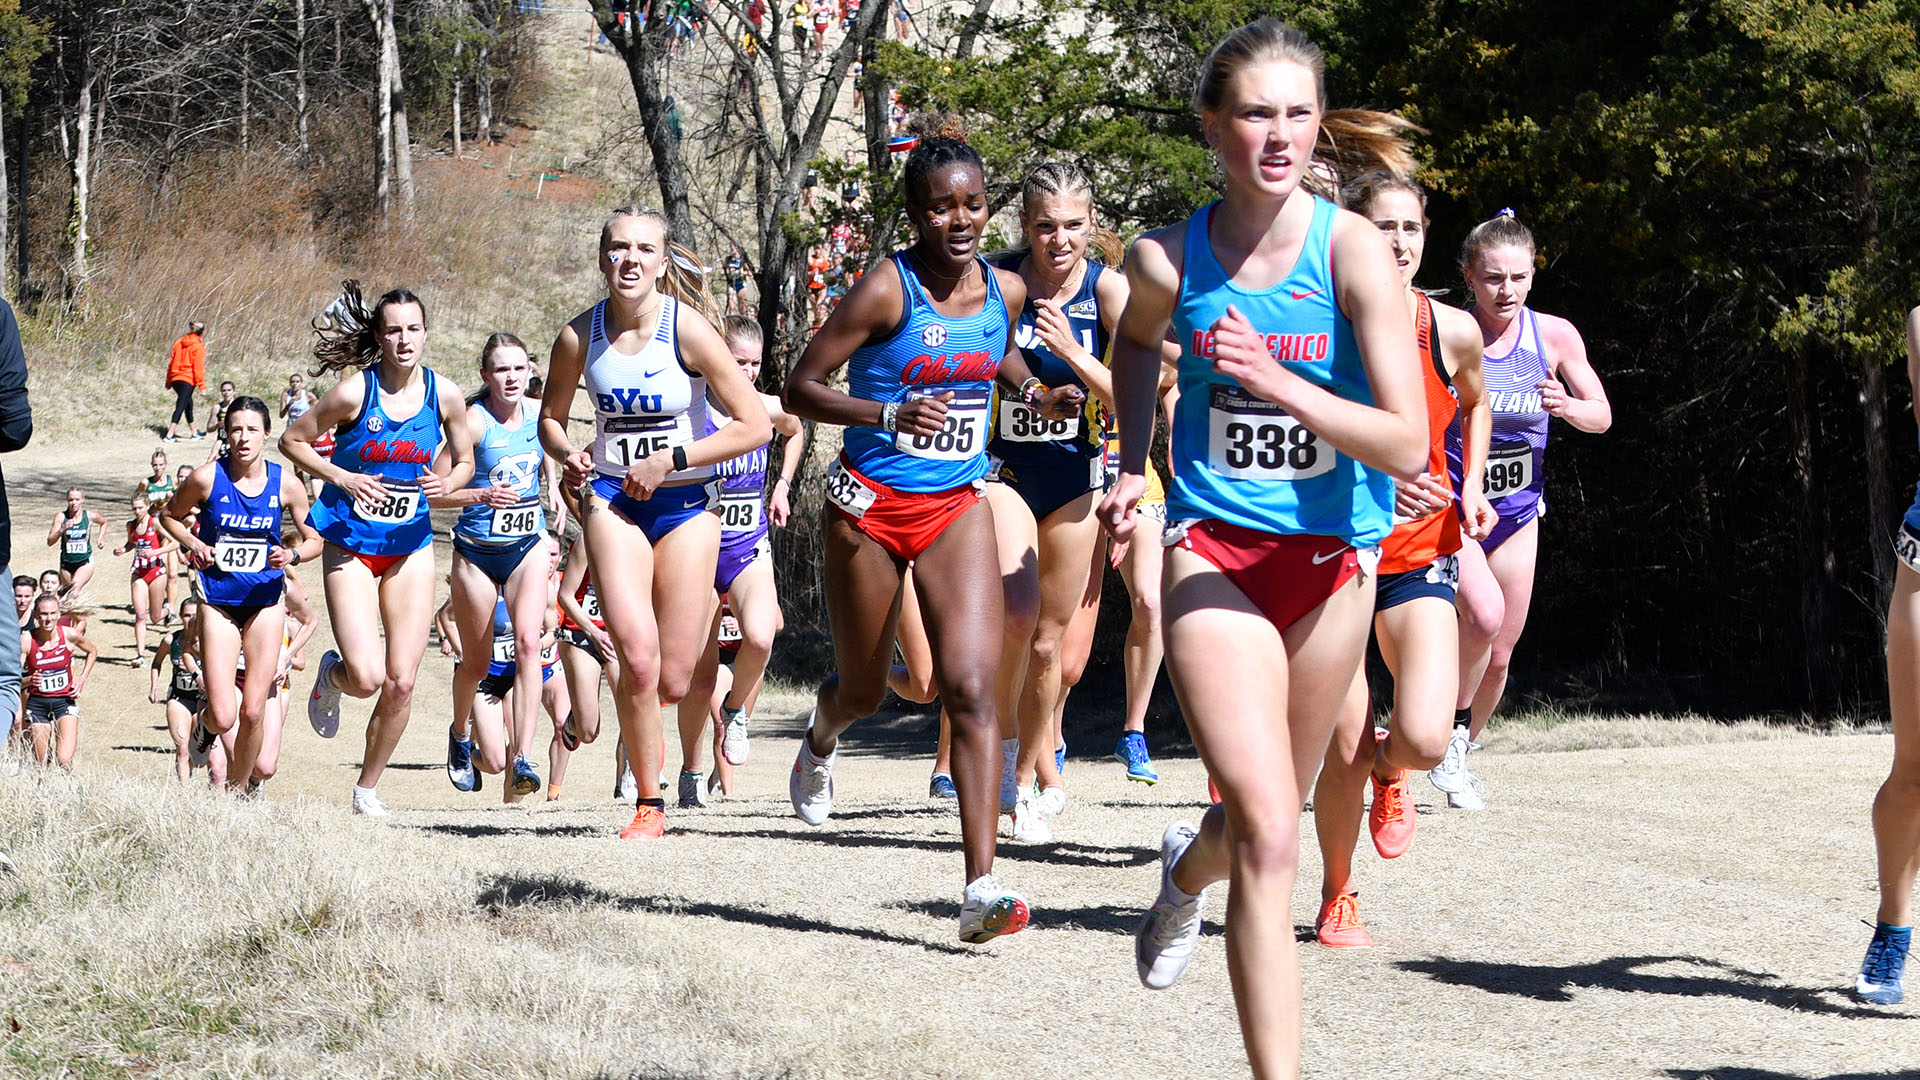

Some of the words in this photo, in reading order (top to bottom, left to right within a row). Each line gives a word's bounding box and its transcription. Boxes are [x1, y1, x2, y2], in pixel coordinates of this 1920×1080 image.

[923, 325, 947, 348] SEC
[1192, 329, 1215, 359] NE
[1259, 333, 1328, 362] EXICO
[901, 353, 951, 386] Ole
[596, 388, 662, 415] BYU
[359, 439, 390, 463] Ole
[388, 439, 431, 464] Miss
[616, 435, 669, 467] 145
[1226, 422, 1317, 470] 338
[365, 494, 410, 519] 86
[220, 513, 274, 529] TULSA
[501, 511, 534, 533] 346
[70, 543, 84, 552] 173
[222, 547, 260, 568] 437
[44, 676, 65, 690] 119
